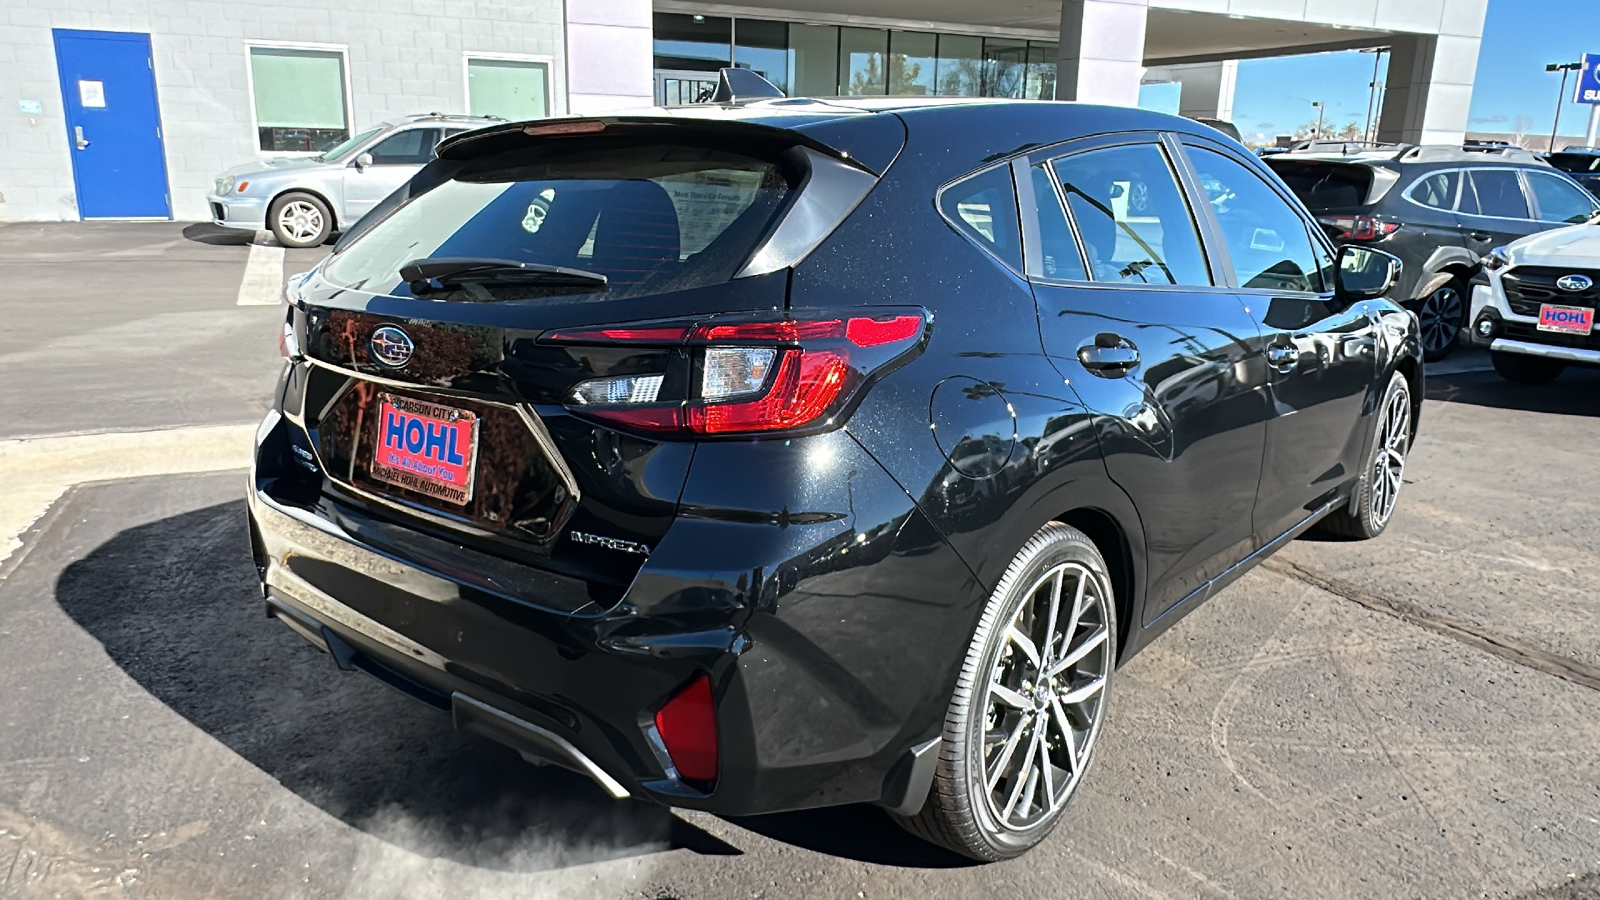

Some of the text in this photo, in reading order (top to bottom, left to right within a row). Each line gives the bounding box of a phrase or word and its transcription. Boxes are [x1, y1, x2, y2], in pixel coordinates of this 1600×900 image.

[1545, 310, 1587, 324] HOHL
[399, 399, 454, 420] CARSON CITY
[385, 412, 464, 466] HOHL
[388, 452, 400, 464] It's
[401, 457, 411, 468] All
[412, 460, 436, 477] About
[371, 466, 466, 502] MICHAEL HOHL AUTOMOTIVE
[570, 530, 650, 556] IMPREZA
